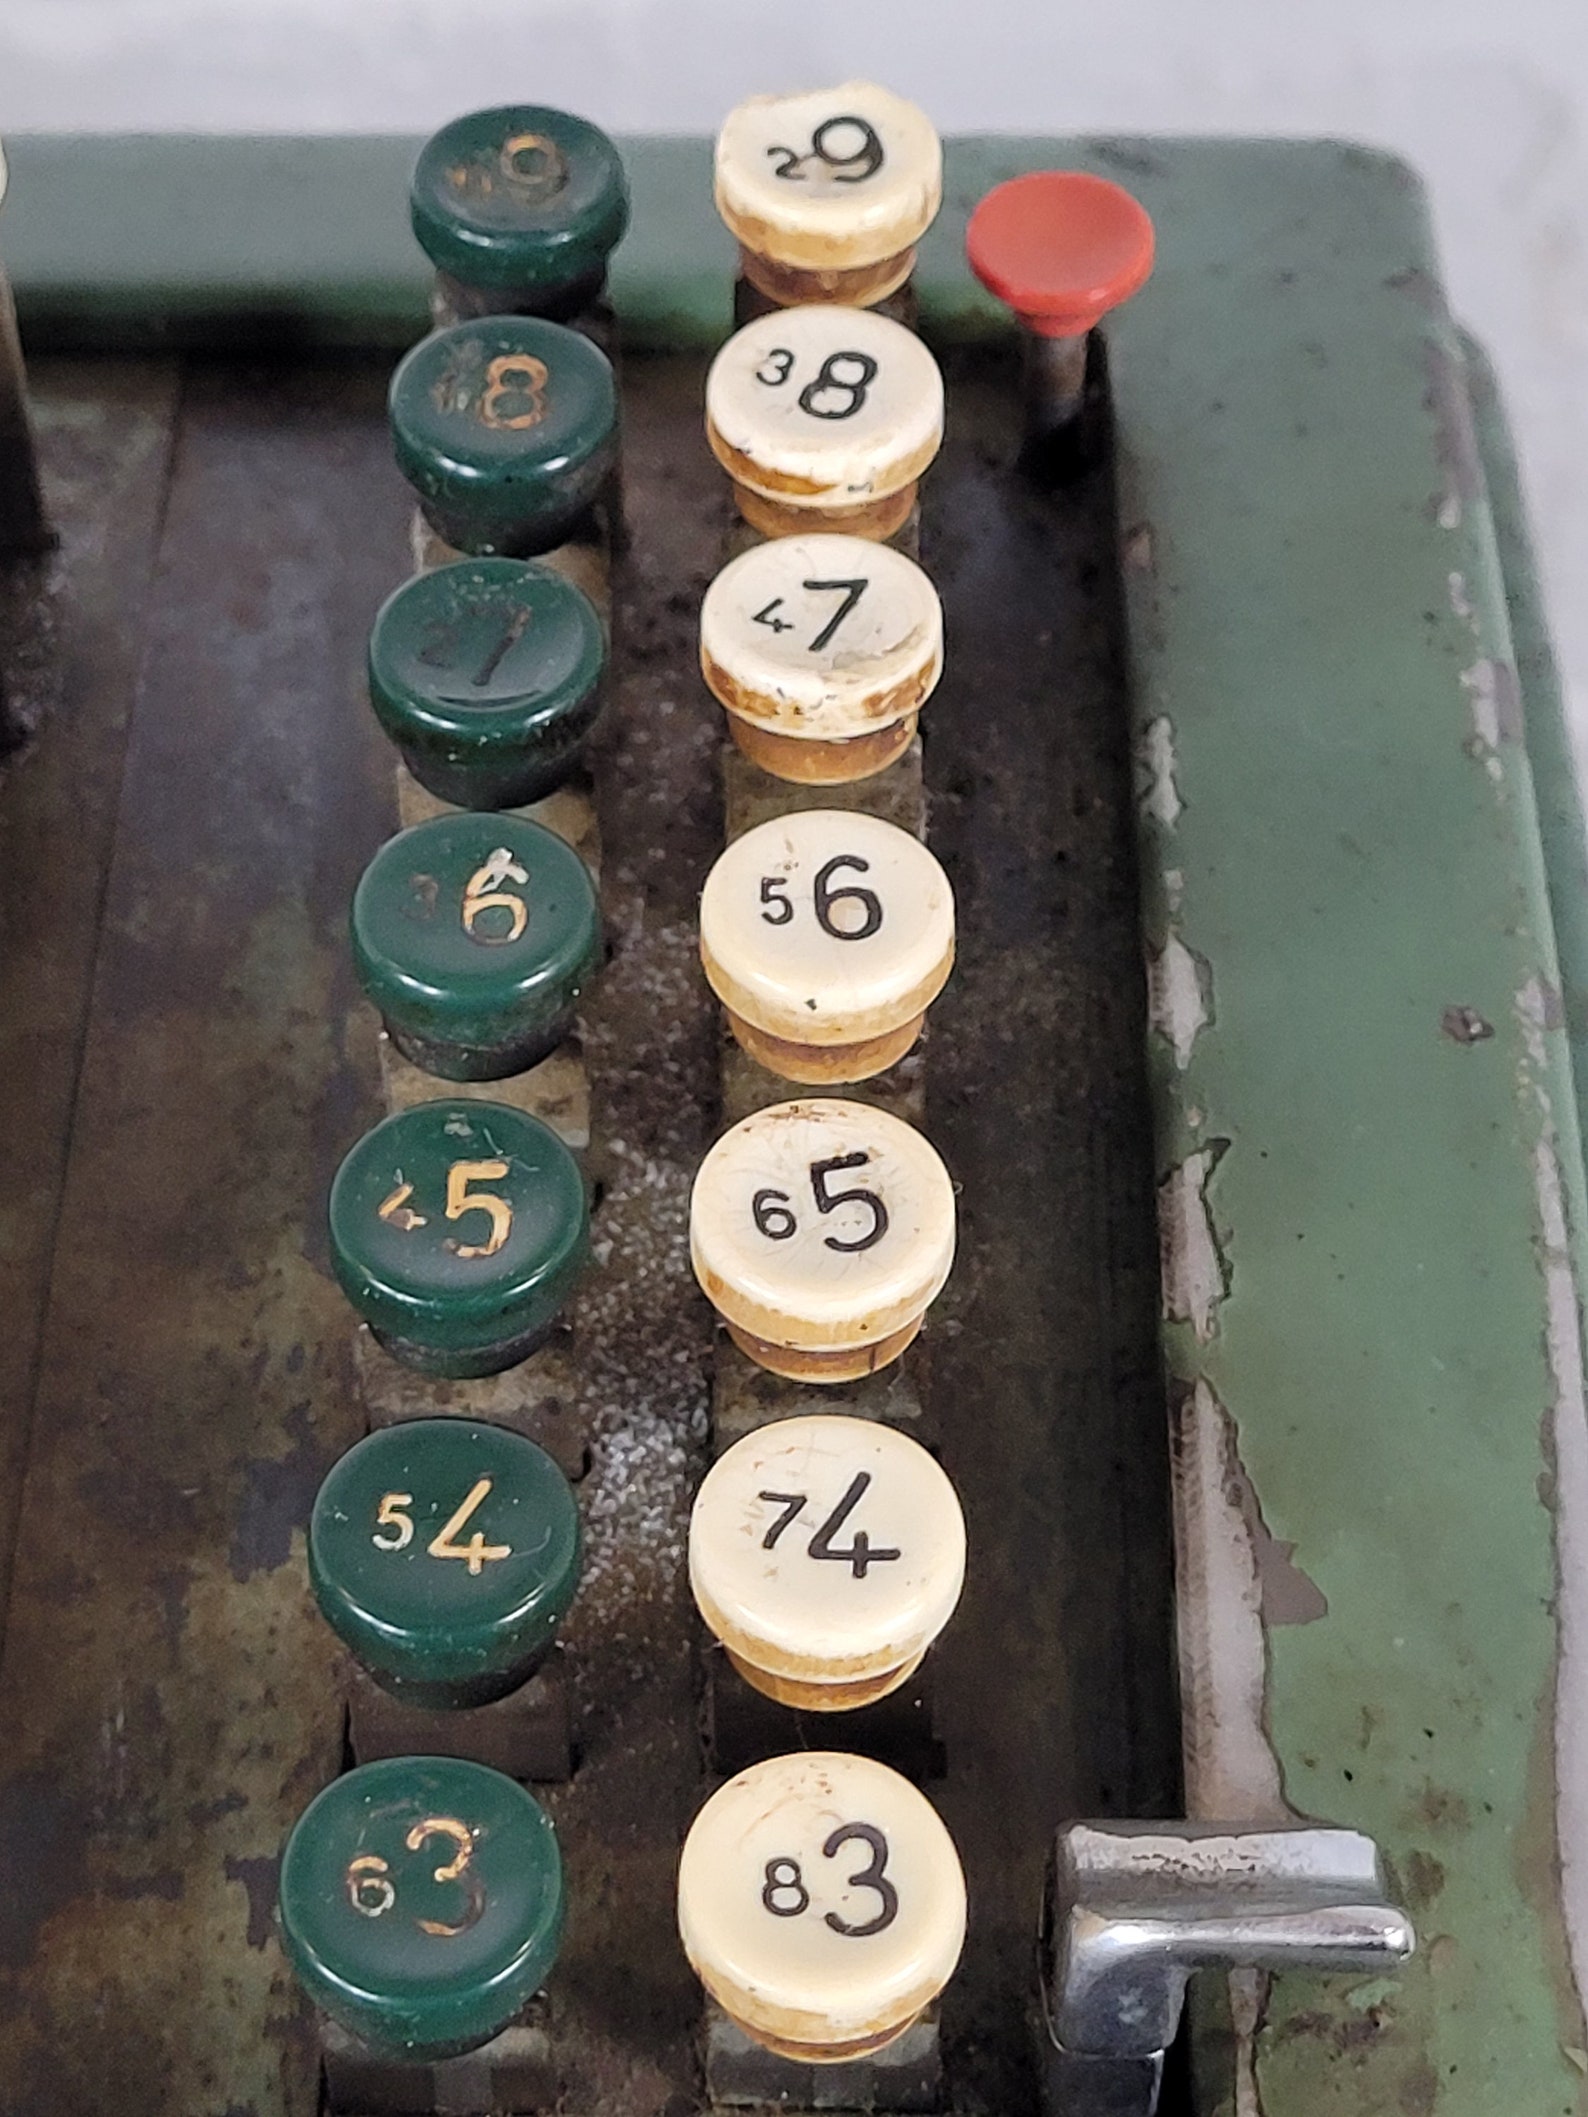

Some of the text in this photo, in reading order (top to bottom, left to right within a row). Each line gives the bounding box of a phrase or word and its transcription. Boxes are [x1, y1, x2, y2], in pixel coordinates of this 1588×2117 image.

[766, 116, 885, 183] 2 9
[476, 353, 549, 430] 8
[756, 348, 879, 420] 3 8
[751, 578, 870, 652] 4 7
[462, 847, 530, 946] 6
[760, 854, 884, 942] 5 6
[378, 1158, 514, 1258] 4 5
[752, 1150, 890, 1253] 6 5
[372, 1471, 513, 1576] 5 4
[758, 1470, 902, 1579] 7 4
[345, 1816, 487, 1937] 6 3
[762, 1820, 900, 1937] 8 3
